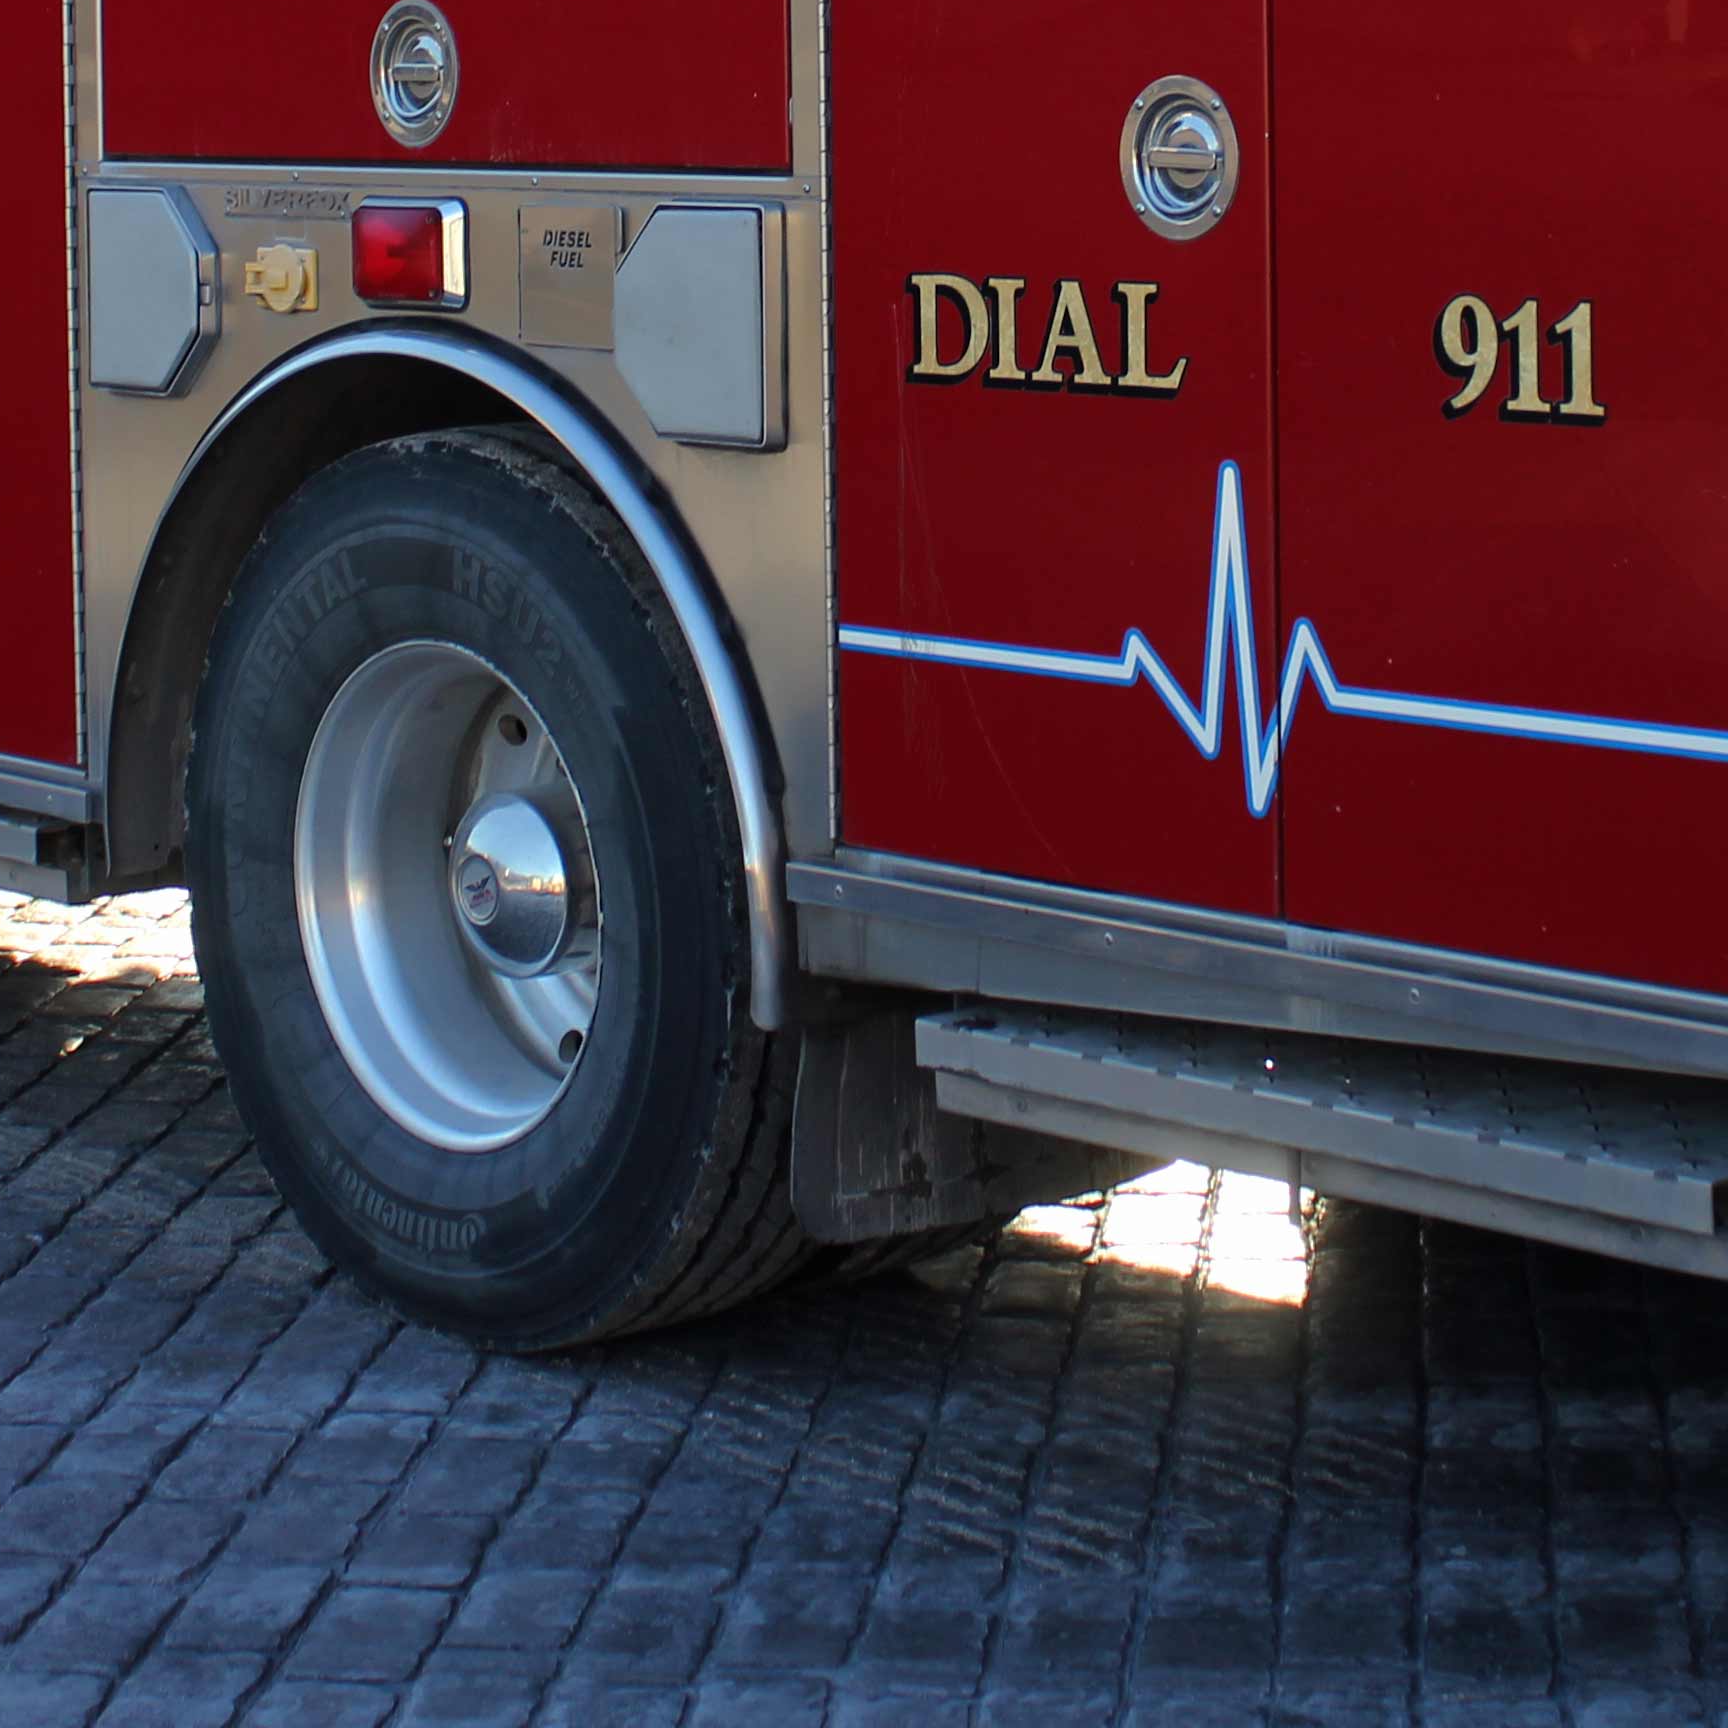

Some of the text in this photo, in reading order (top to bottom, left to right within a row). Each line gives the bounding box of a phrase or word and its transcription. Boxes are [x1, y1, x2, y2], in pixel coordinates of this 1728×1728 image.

[542, 229, 592, 248] DIESEL
[549, 251, 585, 268] FUEL
[906, 273, 1606, 427] DIAL 911
